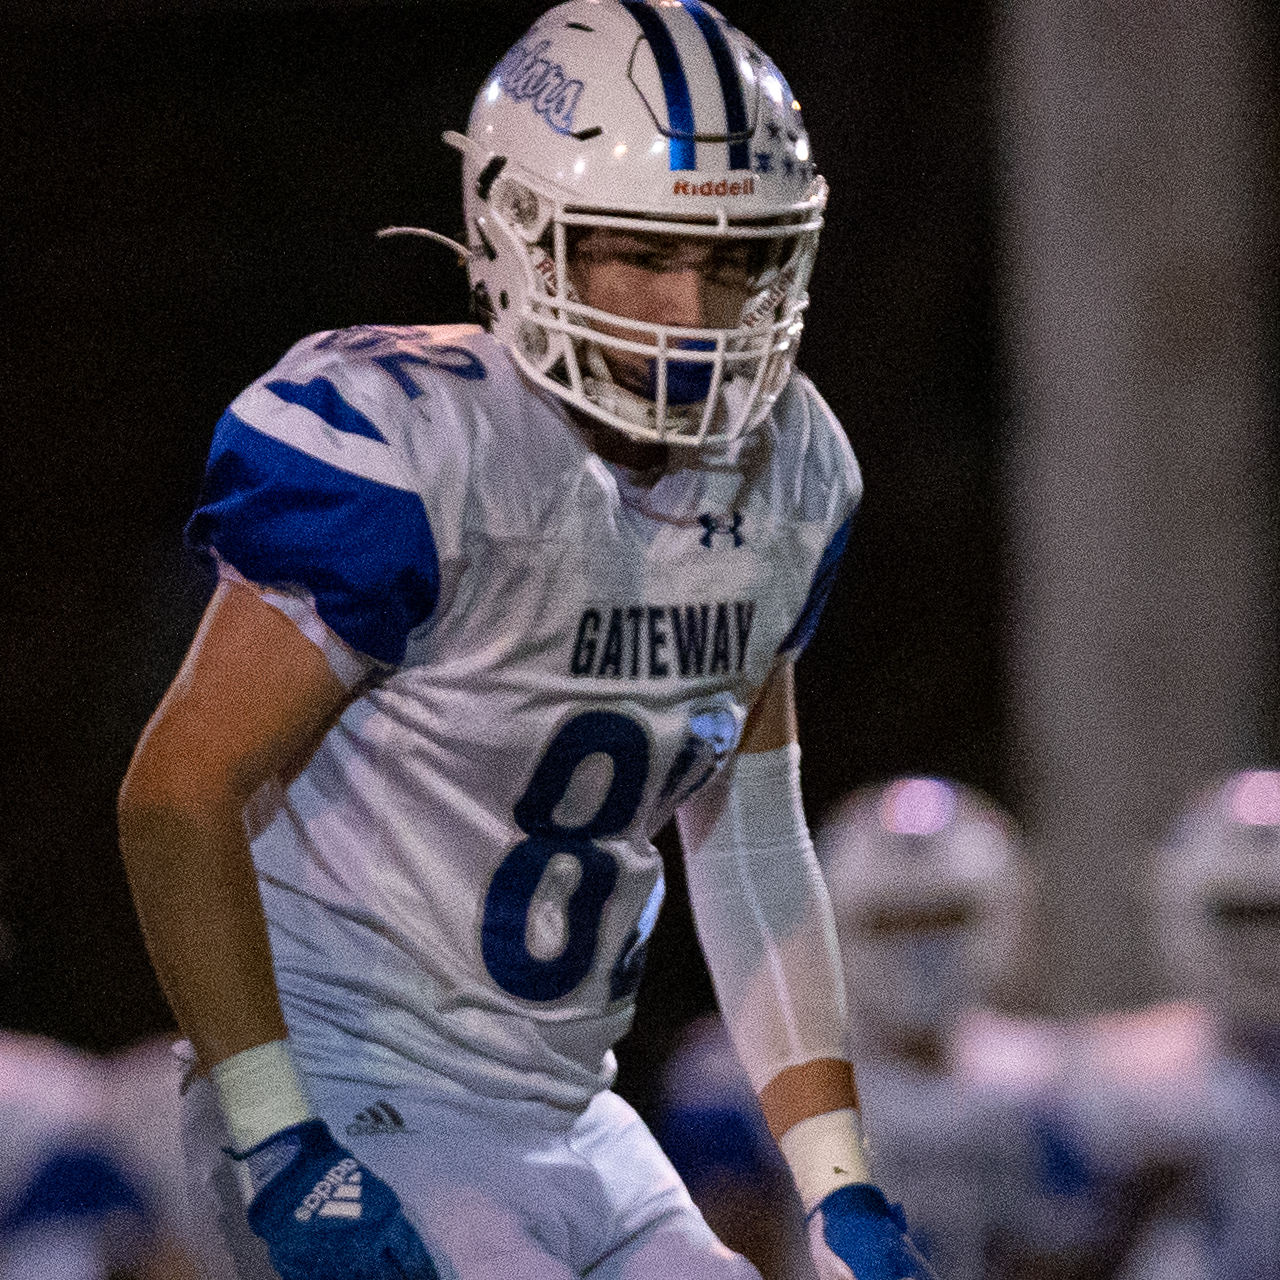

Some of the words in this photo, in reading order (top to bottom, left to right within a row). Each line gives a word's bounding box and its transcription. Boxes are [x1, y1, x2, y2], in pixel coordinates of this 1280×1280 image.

[672, 180, 755, 196] Riddell
[570, 602, 756, 676] GATEWAY
[481, 708, 742, 1001] 8
[294, 1158, 359, 1222] adidas
